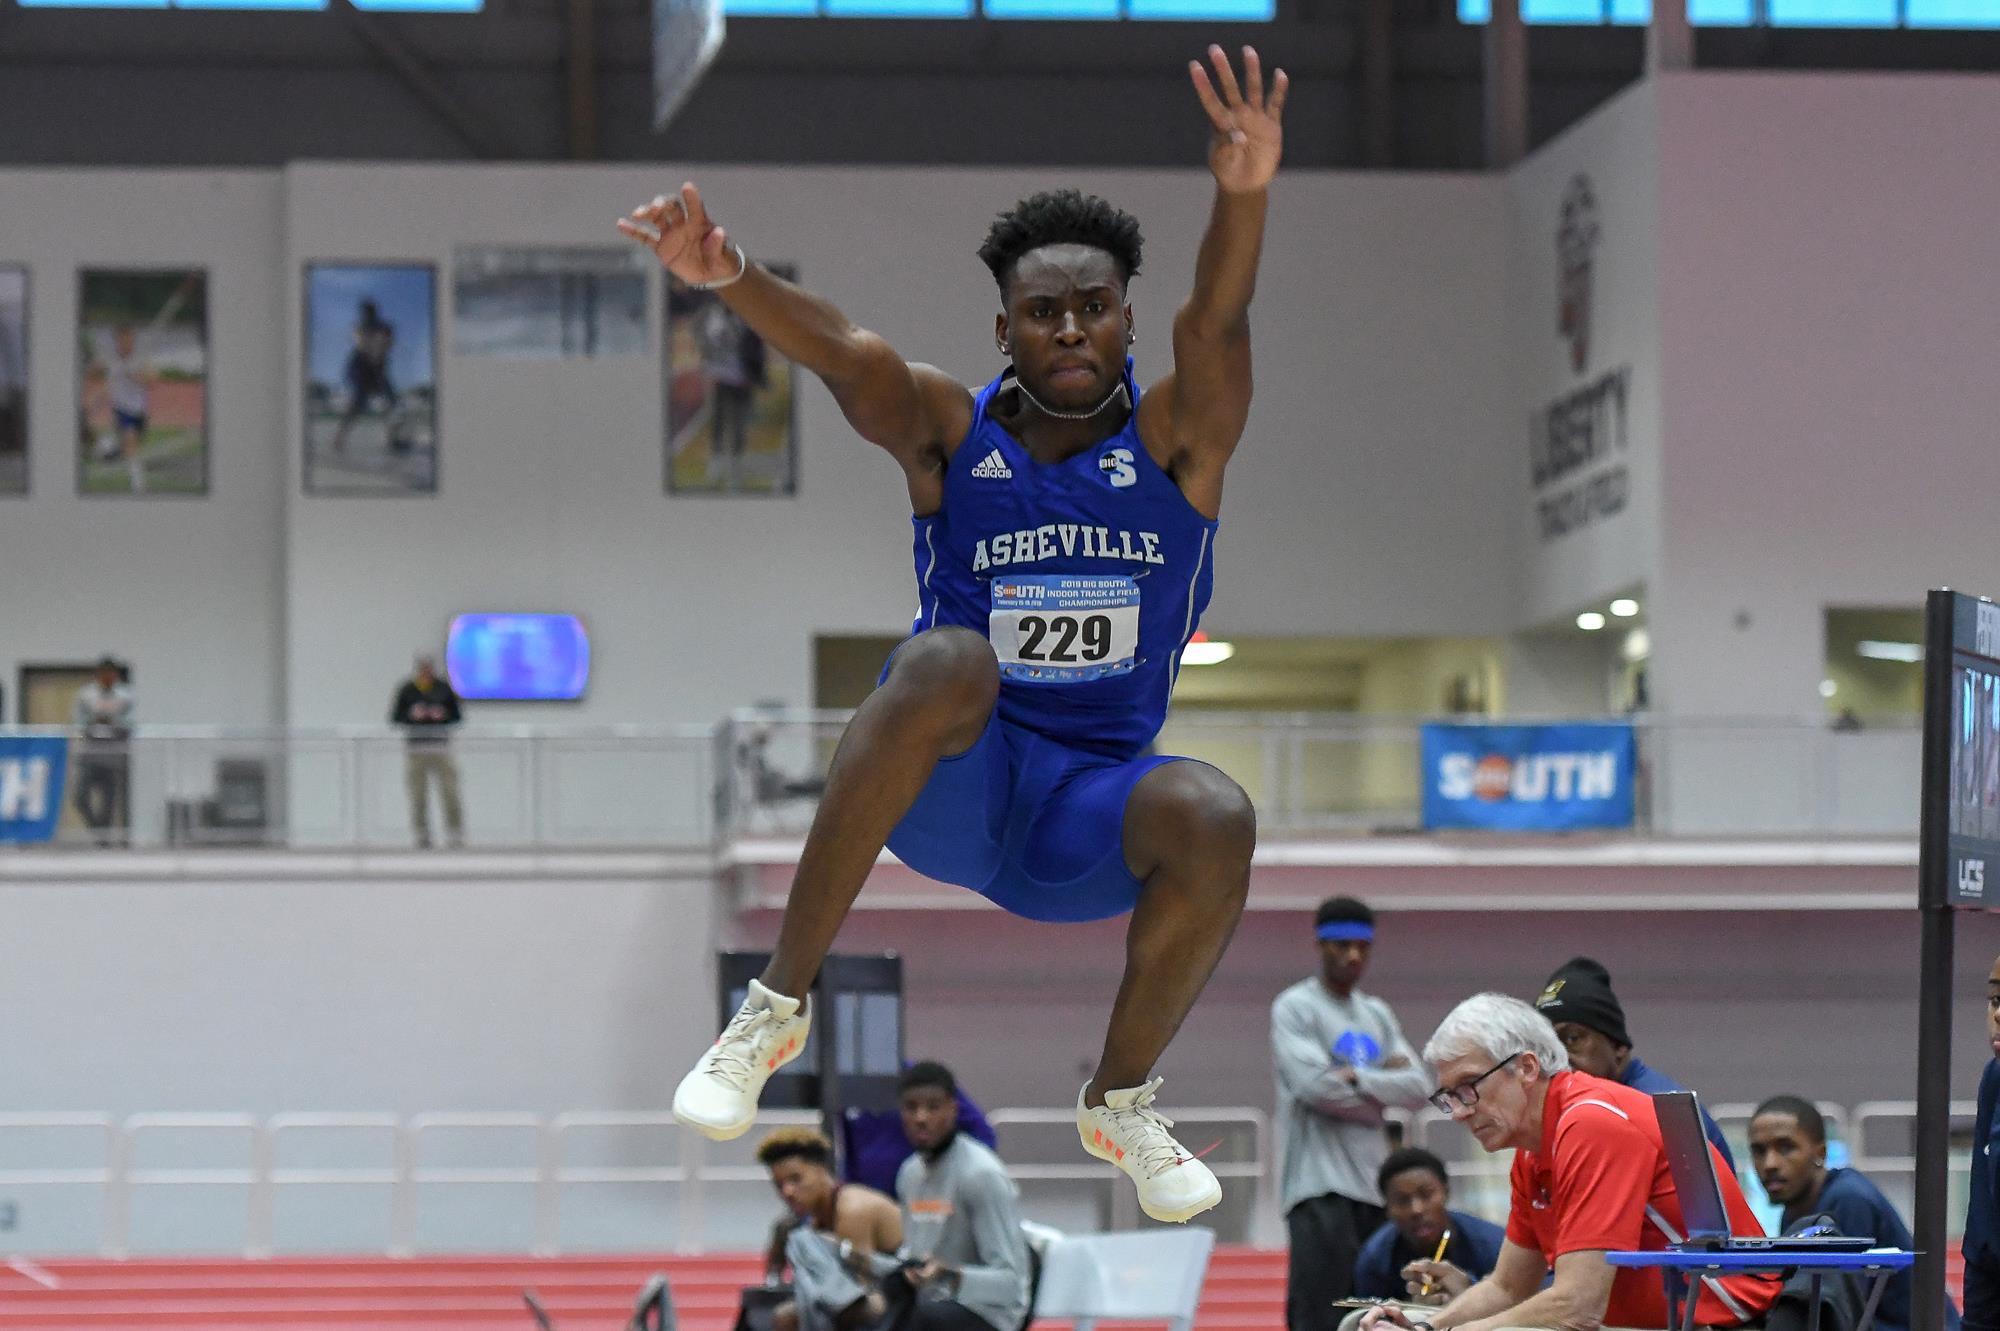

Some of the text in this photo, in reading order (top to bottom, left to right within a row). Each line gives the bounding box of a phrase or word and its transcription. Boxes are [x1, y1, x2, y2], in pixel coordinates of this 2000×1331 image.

[972, 467, 1012, 478] adidas
[972, 523, 1165, 572] ASHEVILLE
[1082, 580, 1097, 588] BIG
[1098, 580, 1127, 588] SOUTH
[1047, 586, 1140, 598] INDOOR TRACK & FIELD
[1059, 598, 1127, 607] CHAMPIONSHIPS
[1018, 615, 1112, 661] 229
